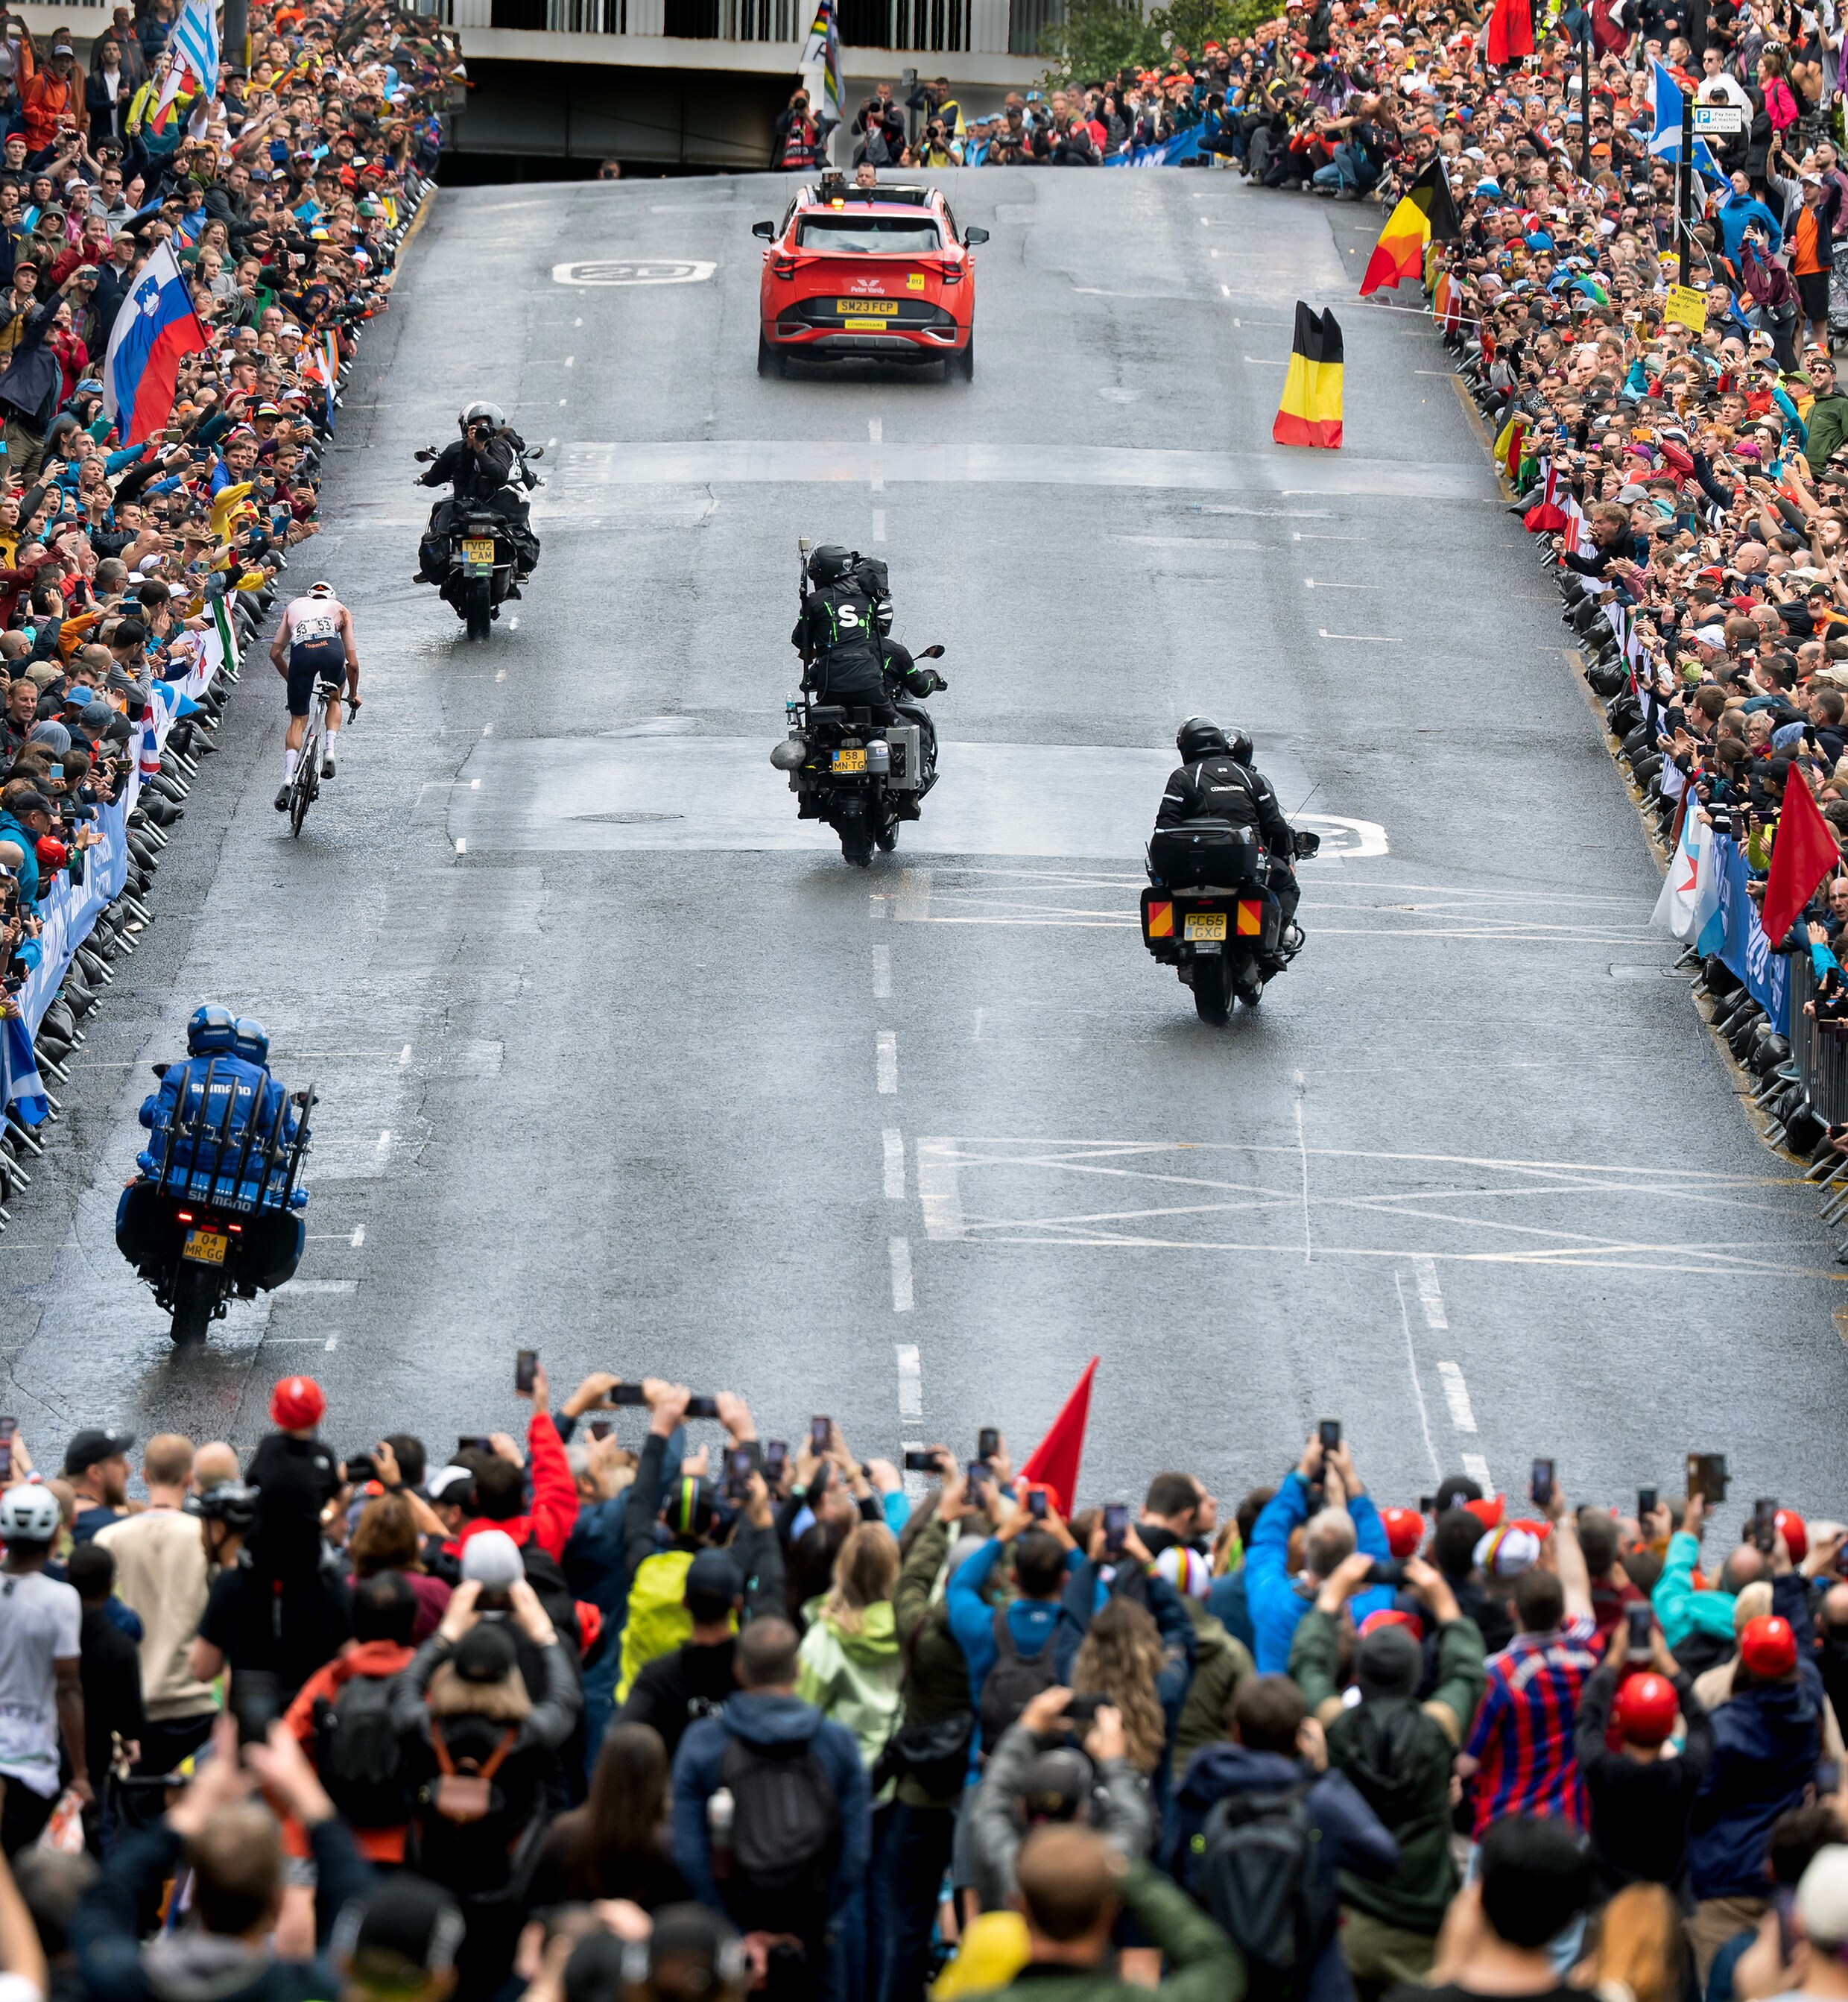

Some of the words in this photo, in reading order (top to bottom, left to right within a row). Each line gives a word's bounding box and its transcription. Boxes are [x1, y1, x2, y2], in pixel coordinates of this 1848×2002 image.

[1681, 288, 1698, 298] PARKING
[841, 301, 870, 312] SM23
[872, 302, 893, 312] FCP
[464, 542, 493, 550] TV02
[470, 552, 492, 560] CAM
[296, 623, 307, 637] 53
[317, 620, 332, 631] 53
[304, 640, 328, 648] TeamNL
[846, 751, 858, 760] 58
[1188, 915, 1224, 926] GC65
[1194, 927, 1222, 938] GXG
[188, 1190, 252, 1212] SHMANO
[201, 1234, 218, 1247] 04
